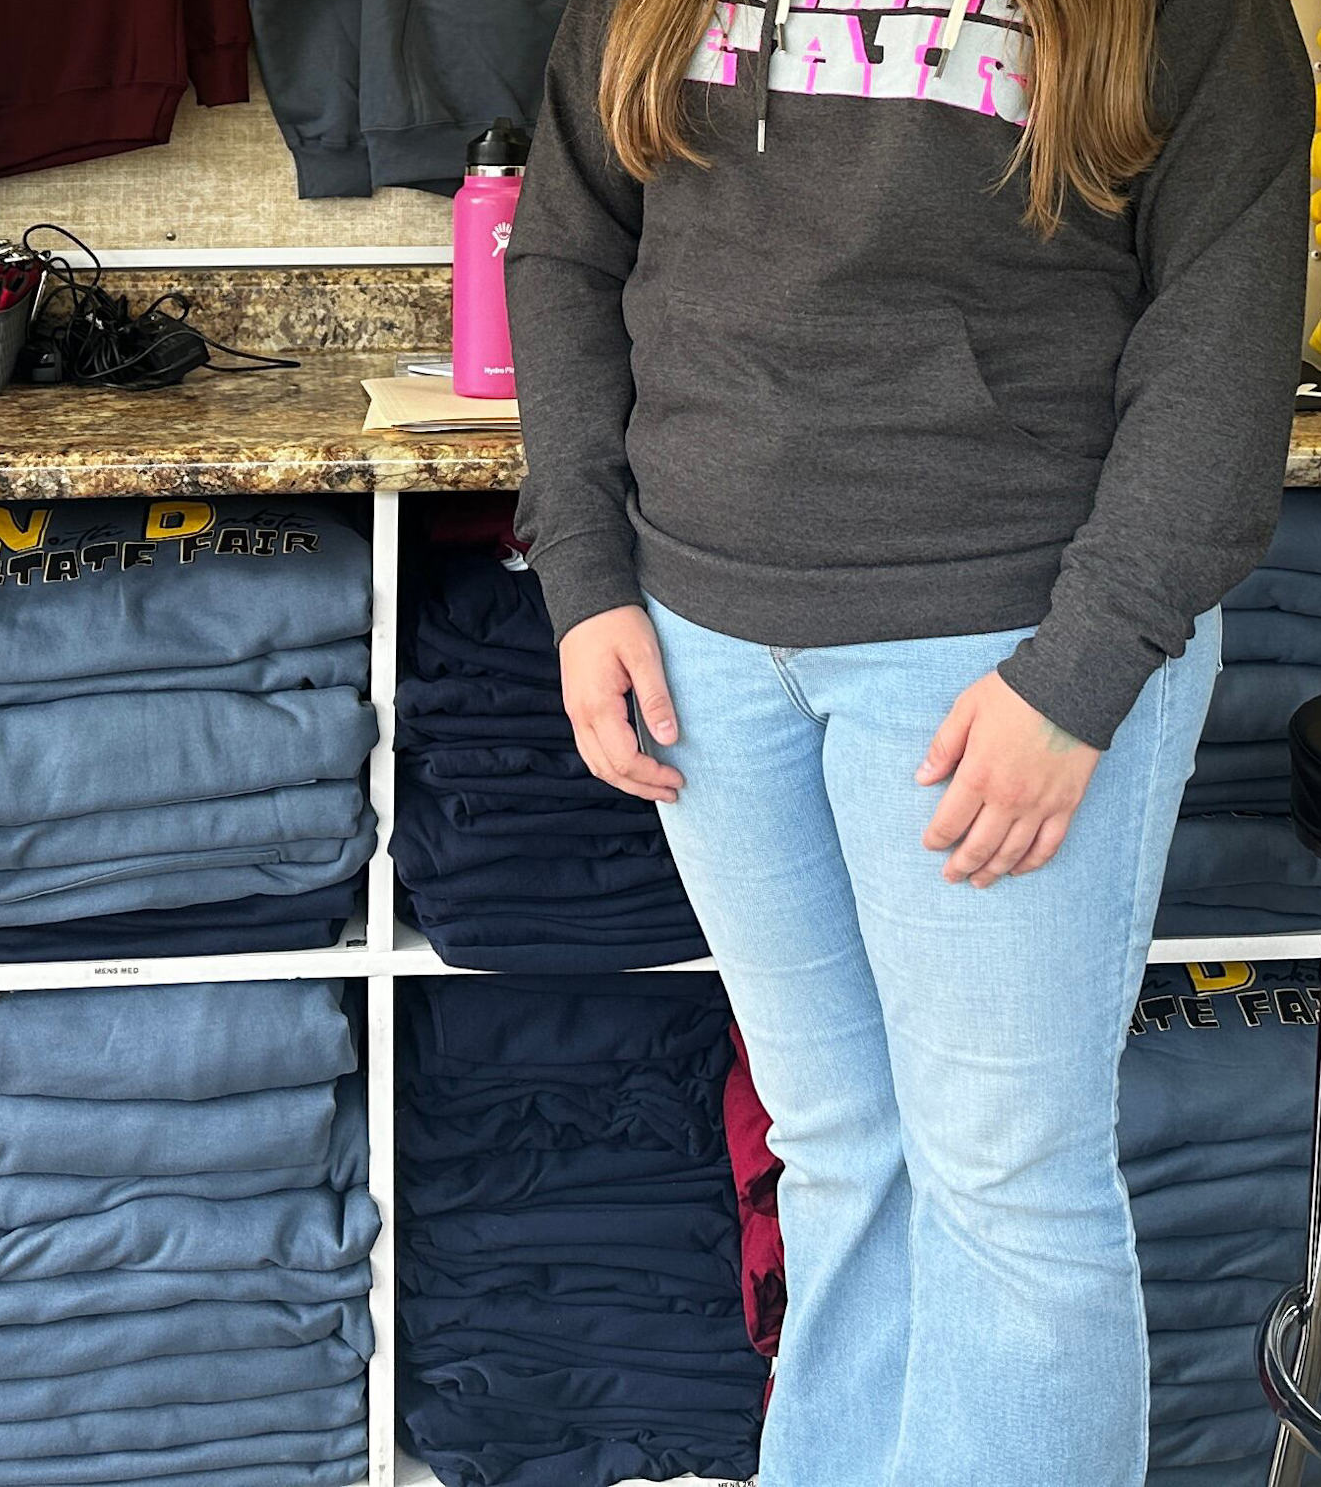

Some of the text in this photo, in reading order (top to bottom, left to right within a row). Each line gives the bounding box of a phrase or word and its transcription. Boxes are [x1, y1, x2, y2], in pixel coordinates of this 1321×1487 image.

[483, 367, 504, 376] Hydro
[144, 500, 320, 542] Dakota
[178, 527, 321, 566] FAIR
[94, 967, 139, 975] MENS MED
